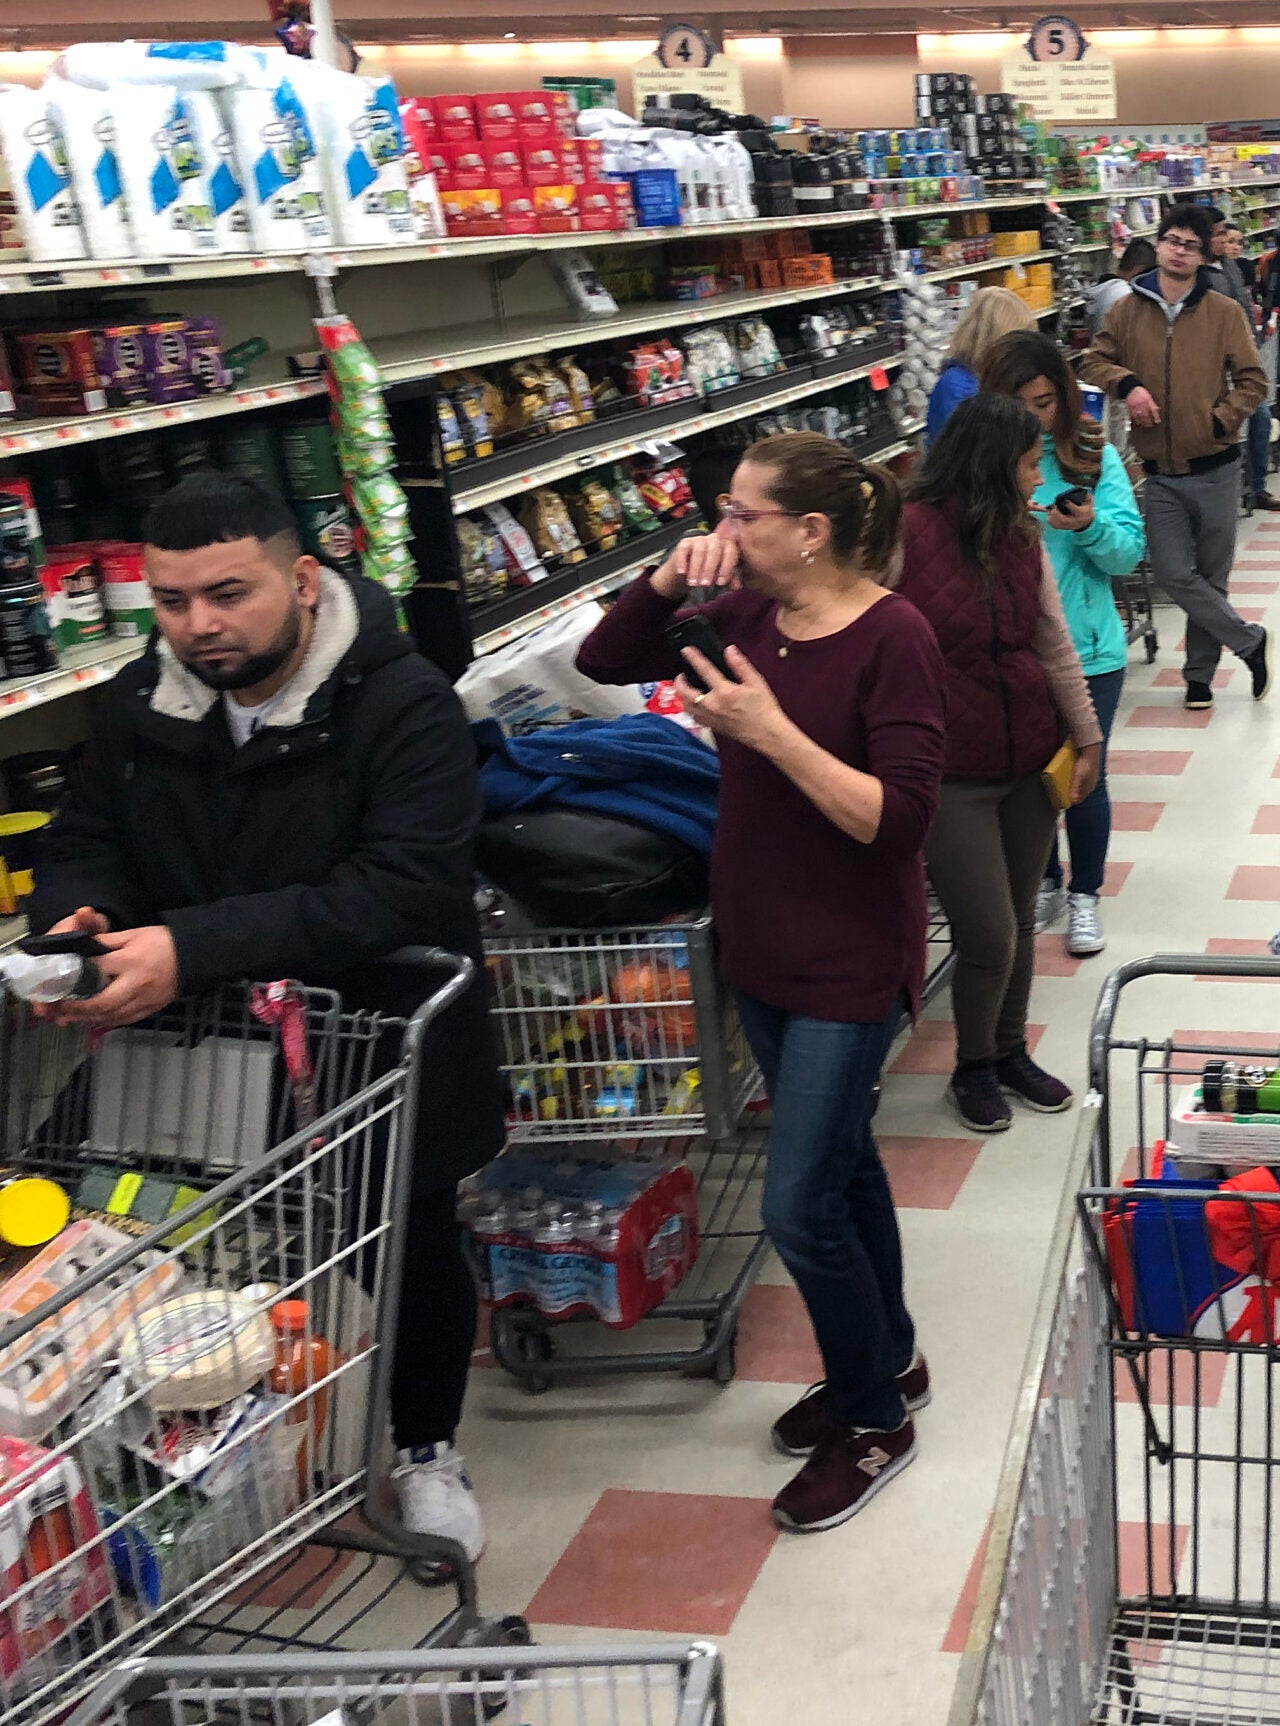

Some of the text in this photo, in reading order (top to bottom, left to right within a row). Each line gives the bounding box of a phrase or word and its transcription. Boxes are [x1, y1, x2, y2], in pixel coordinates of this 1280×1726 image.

[674, 37, 692, 62] 4
[1048, 29, 1065, 55] 5
[856, 1446, 892, 1477] N
